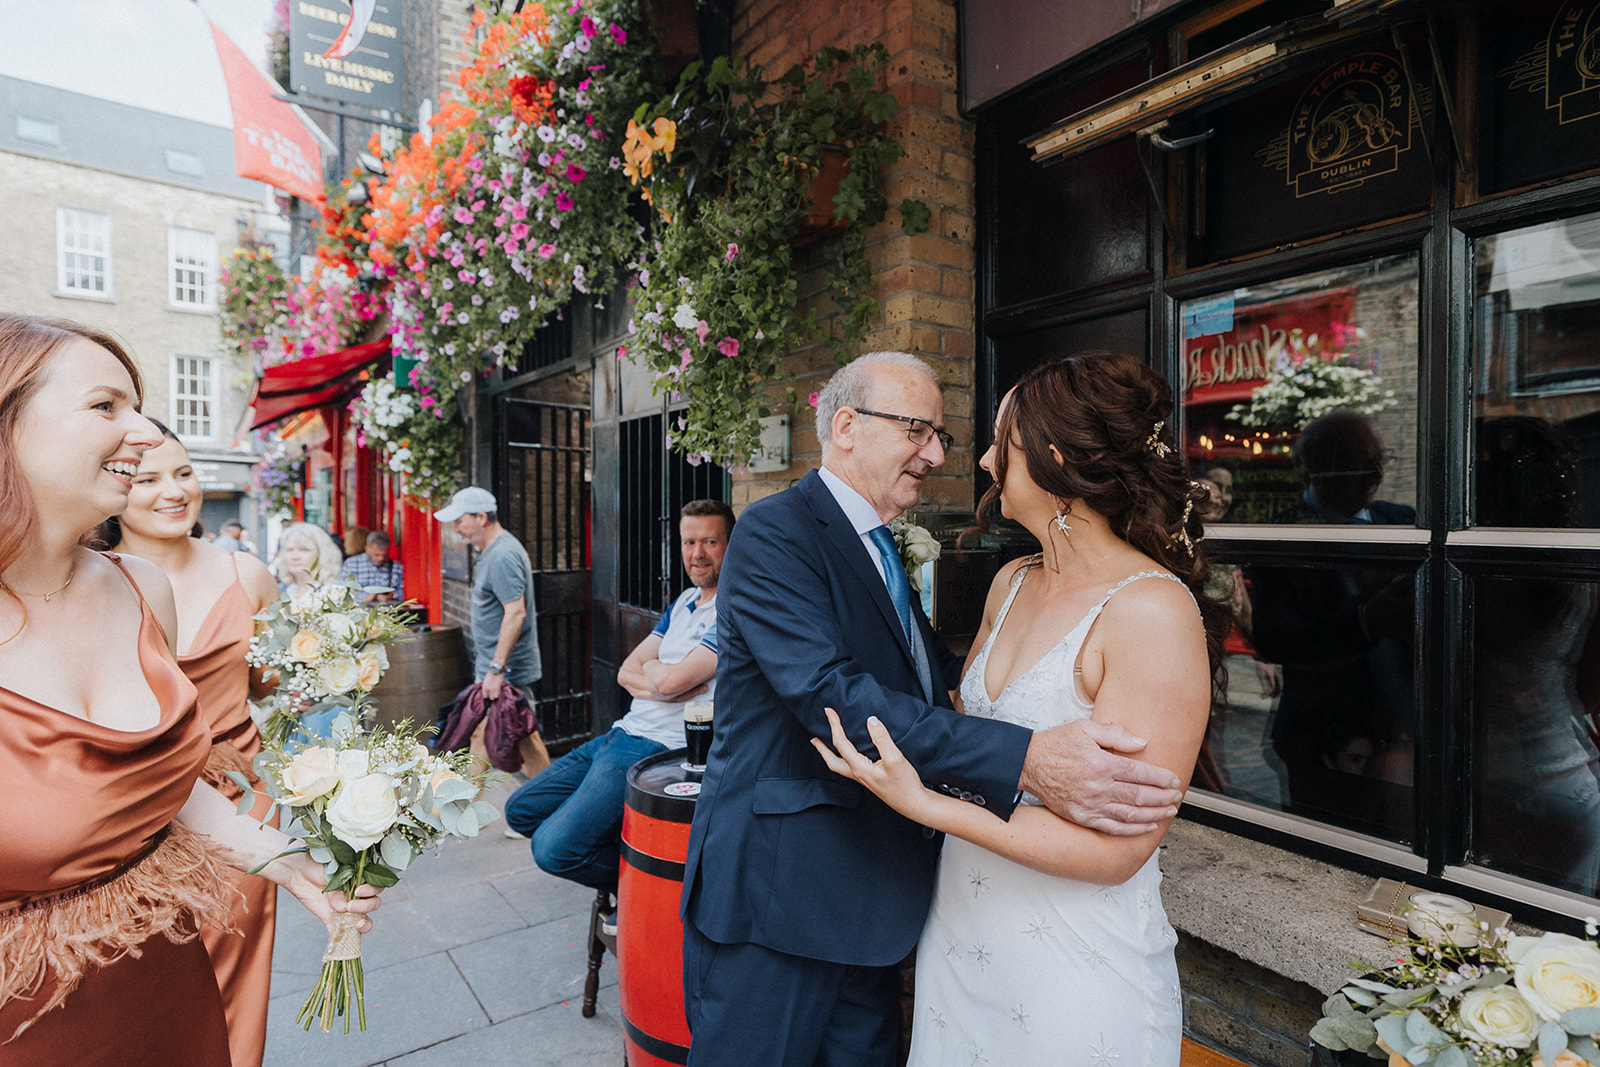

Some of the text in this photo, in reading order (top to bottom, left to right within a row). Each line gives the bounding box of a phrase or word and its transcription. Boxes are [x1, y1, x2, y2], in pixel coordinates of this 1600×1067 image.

[299, 1, 397, 39] BEER GDEN
[1555, 7, 1585, 58] THE
[303, 51, 395, 84] LIVE MUSIC
[324, 71, 376, 94] DAILY
[1294, 60, 1404, 145] THE TEMPLE BAR
[1320, 158, 1372, 180] DUBLIN
